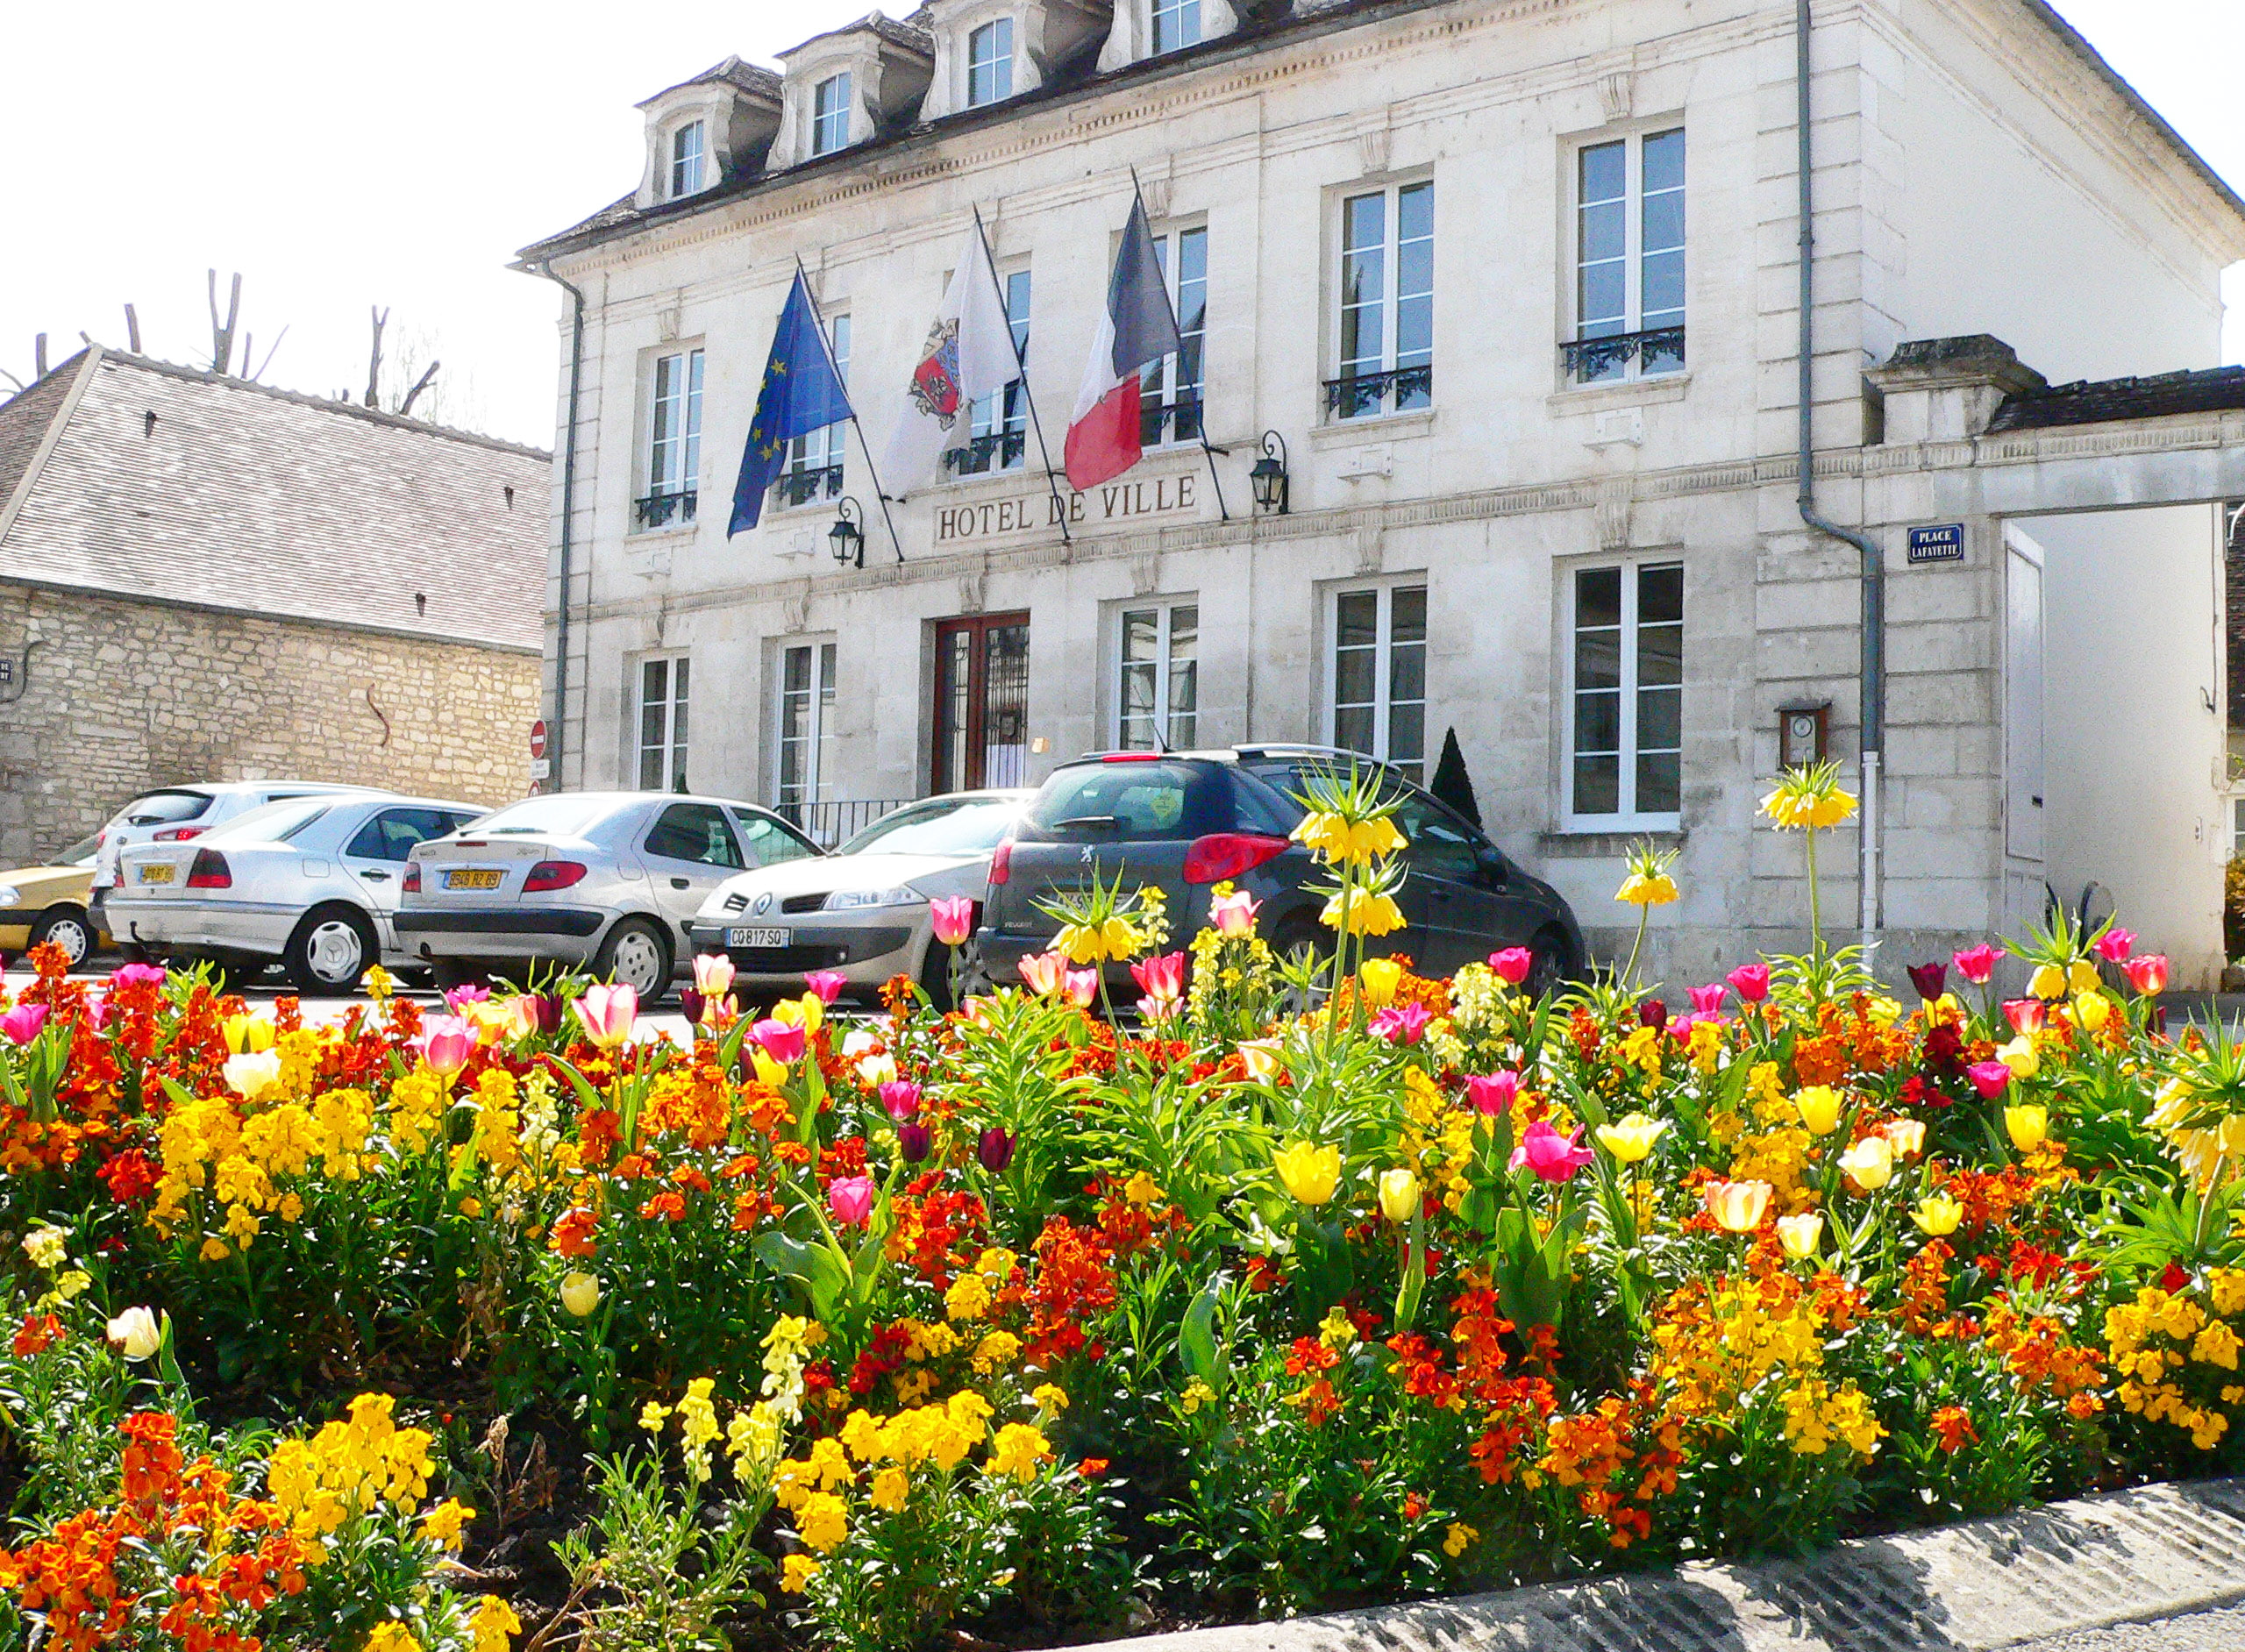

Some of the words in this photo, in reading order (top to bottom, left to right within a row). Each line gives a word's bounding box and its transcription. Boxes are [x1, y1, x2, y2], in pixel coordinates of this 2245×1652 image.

[939, 500, 1034, 539] HOTEL
[1047, 491, 1087, 525] DE
[1101, 475, 1196, 518] VILLE
[1919, 530, 1952, 543] PLACE
[1912, 544, 1958, 558] LAFAYETTE
